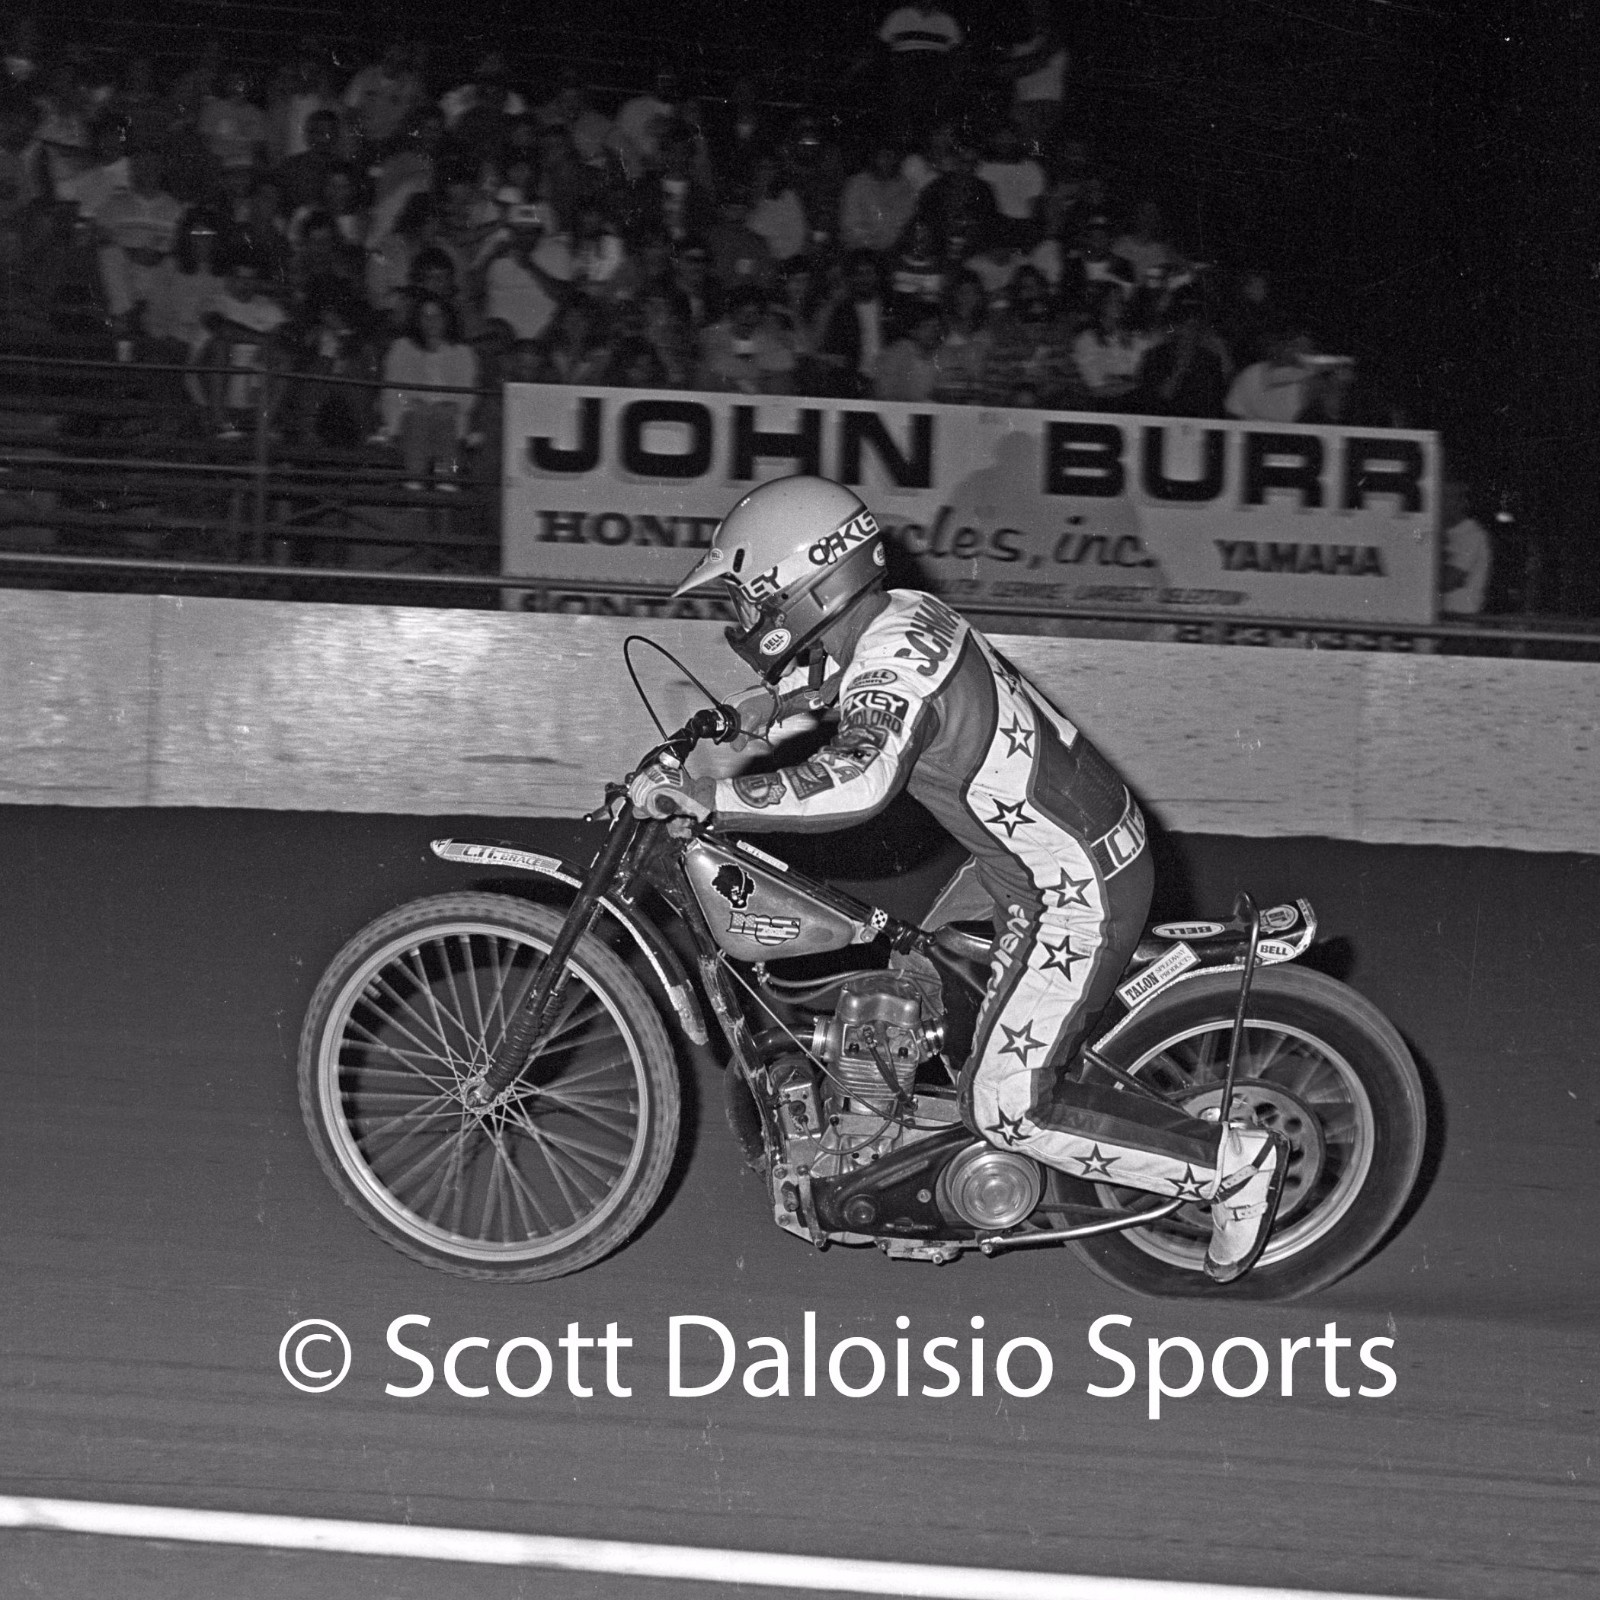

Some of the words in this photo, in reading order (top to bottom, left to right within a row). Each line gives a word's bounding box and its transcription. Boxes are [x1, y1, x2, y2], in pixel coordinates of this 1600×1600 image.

[526, 397, 936, 489] JOHN
[1041, 421, 1426, 513] BURR
[535, 510, 724, 549] HOND
[1053, 515, 1159, 568] inc.
[1214, 540, 1388, 578] YAMAHA
[763, 634, 784, 651] BELL
[1163, 925, 1213, 936] BELL
[1155, 948, 1186, 973] SPEEDWAY
[1260, 945, 1288, 956] BELL
[1160, 955, 1192, 981] PRODUCTS
[1125, 971, 1160, 1001] TALON
